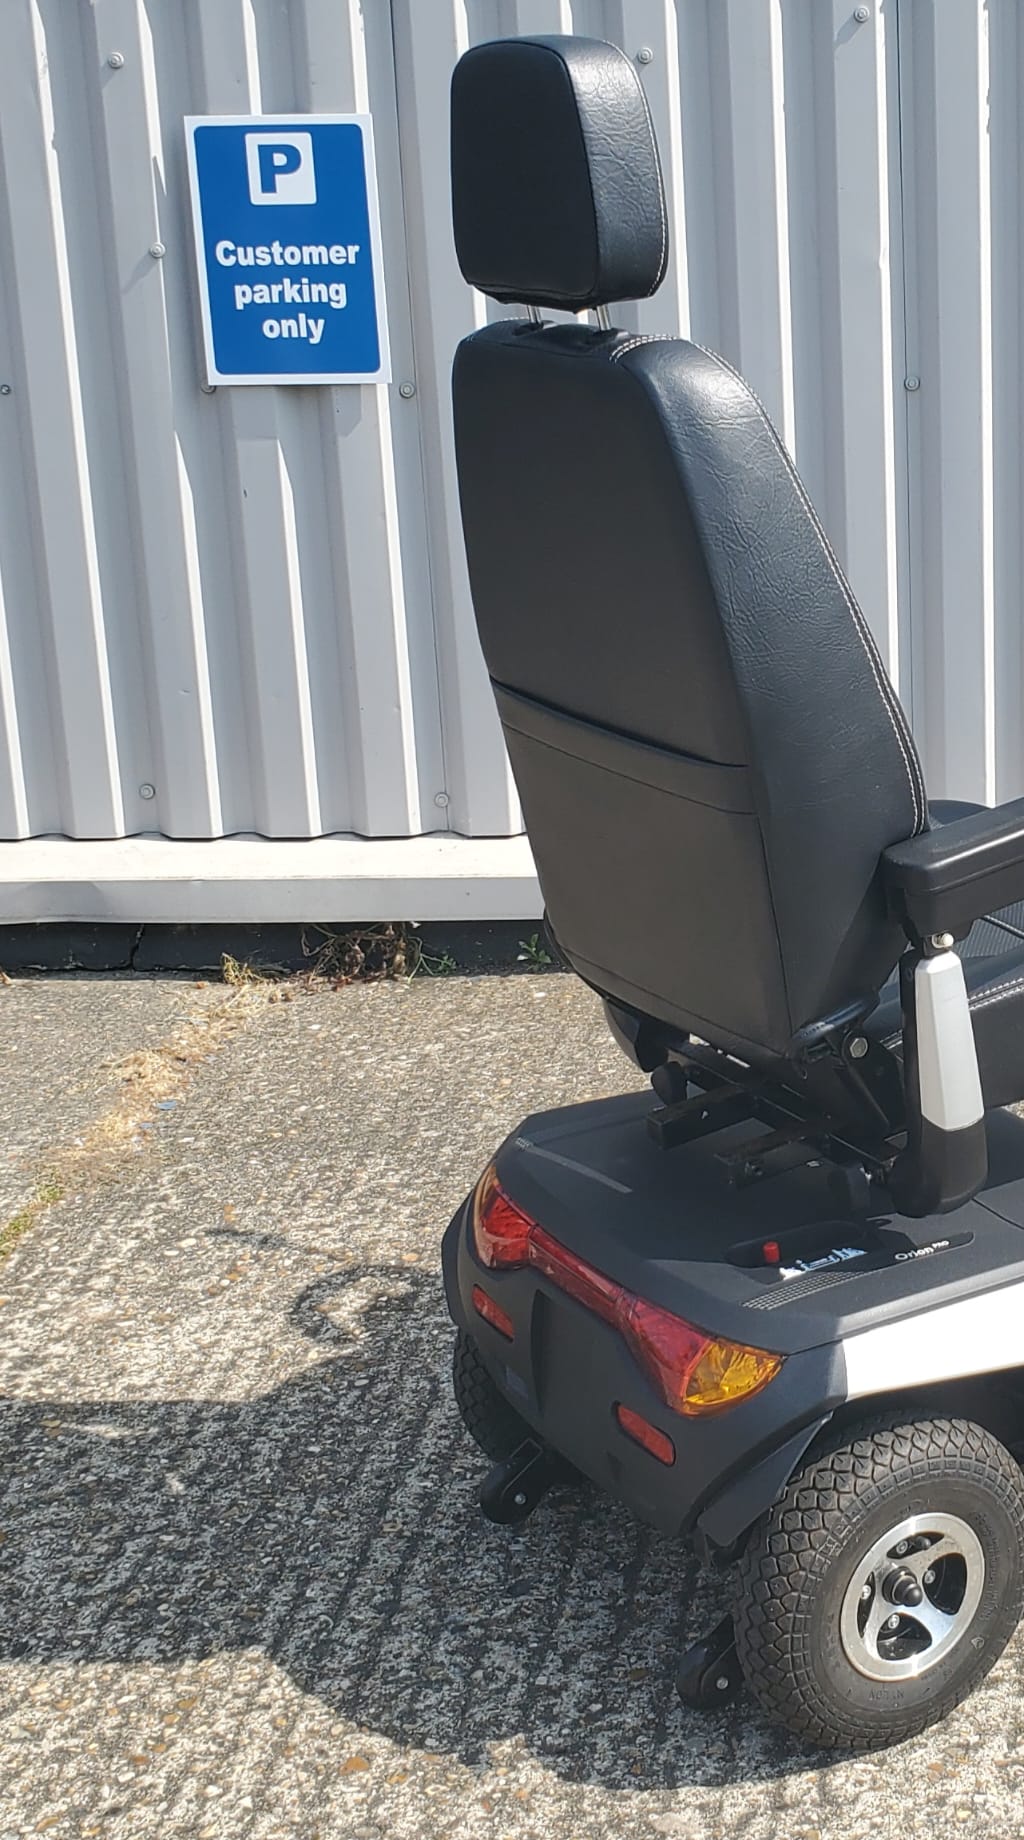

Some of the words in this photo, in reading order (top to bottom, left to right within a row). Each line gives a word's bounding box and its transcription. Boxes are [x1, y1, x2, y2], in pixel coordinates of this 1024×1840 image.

[257, 143, 302, 194] P
[215, 240, 360, 267] Customer
[235, 278, 348, 310] parking
[262, 313, 325, 345] only
